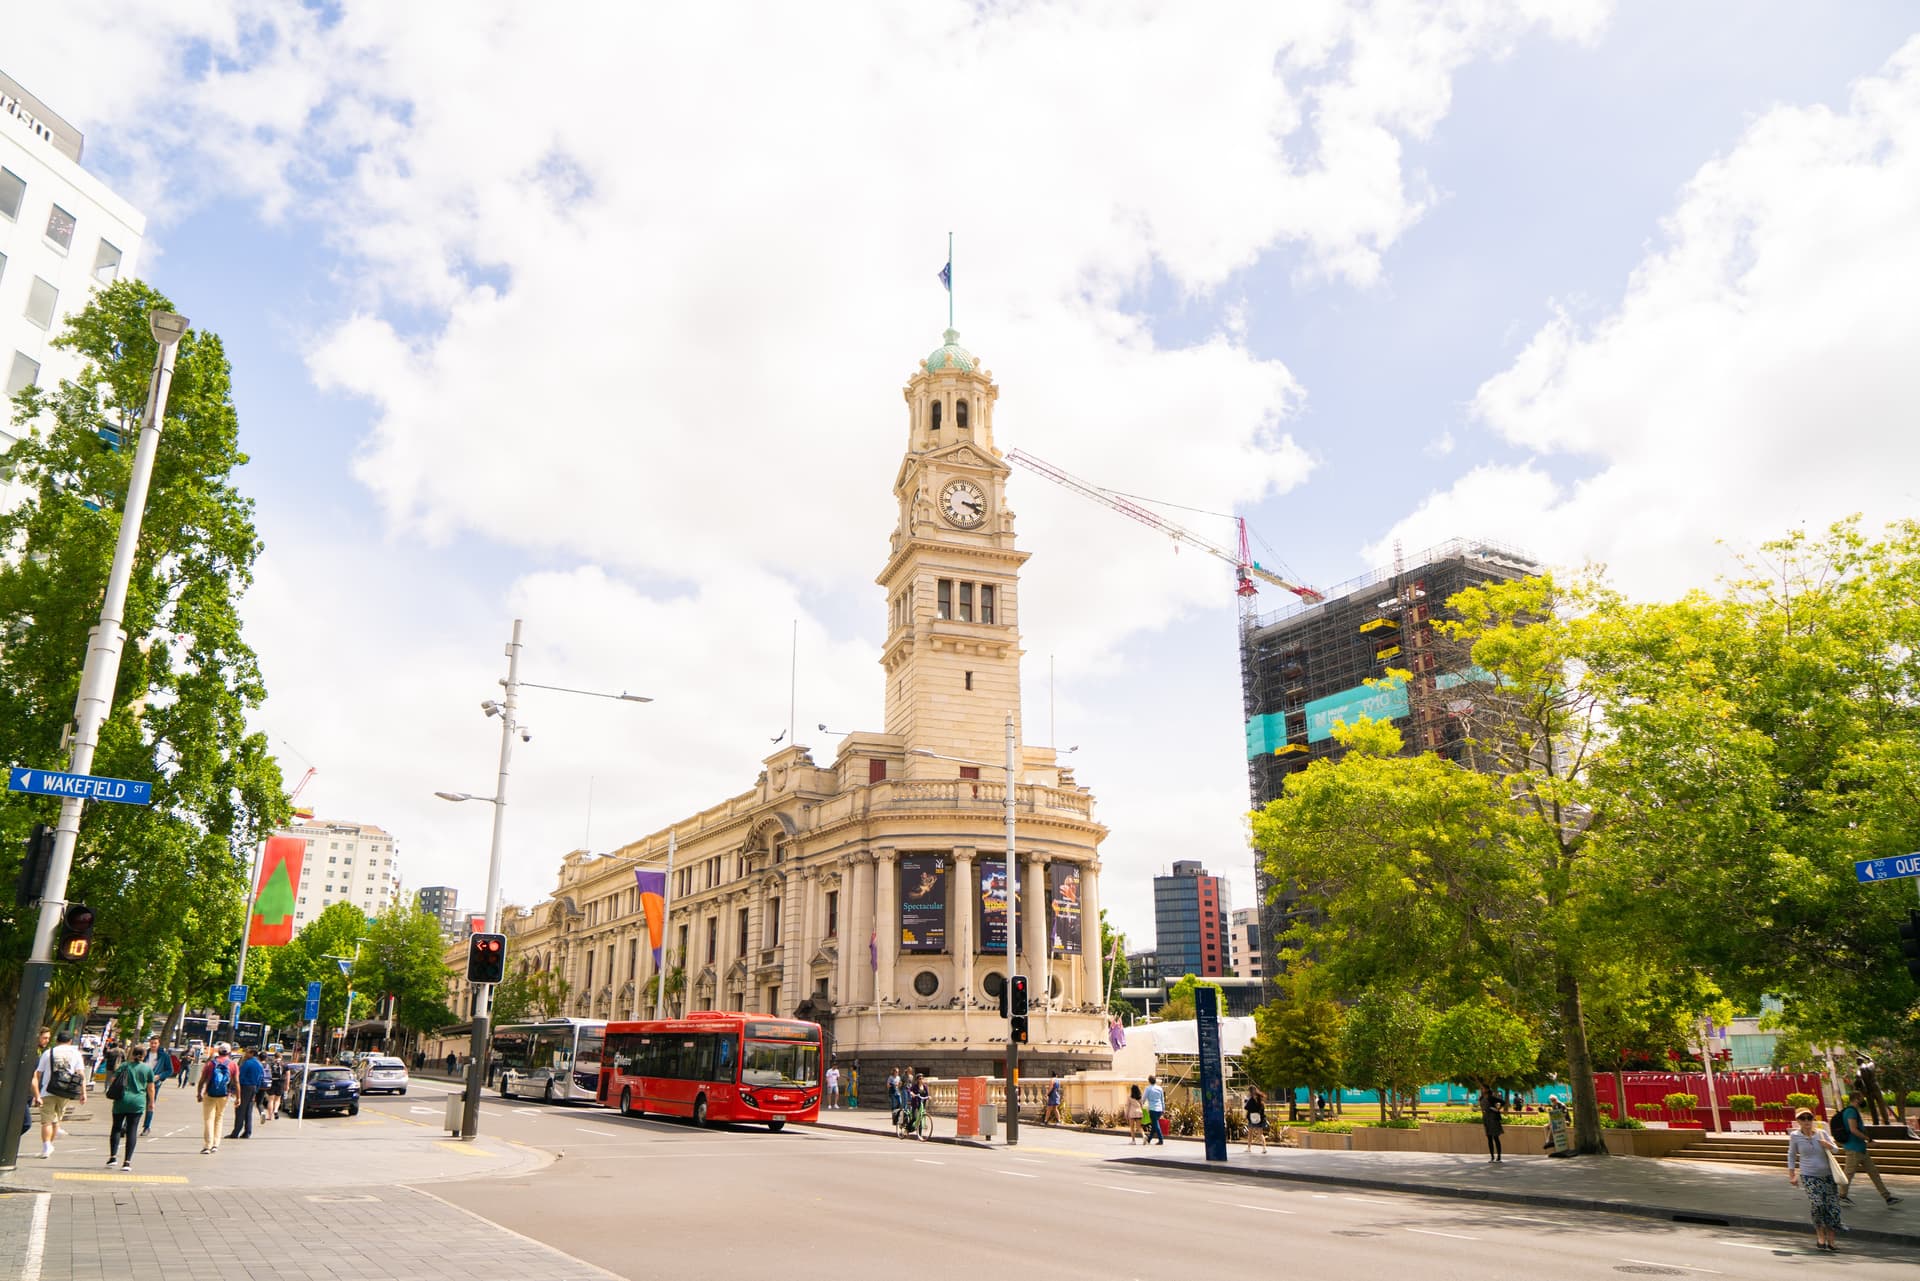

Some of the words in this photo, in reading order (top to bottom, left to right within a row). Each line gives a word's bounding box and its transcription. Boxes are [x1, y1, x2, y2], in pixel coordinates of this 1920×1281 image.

[43, 774, 126, 798] WAKEFIELD
[133, 784, 144, 793] ST
[903, 902, 943, 911] Spectacular
[69, 940, 87, 956] 10
